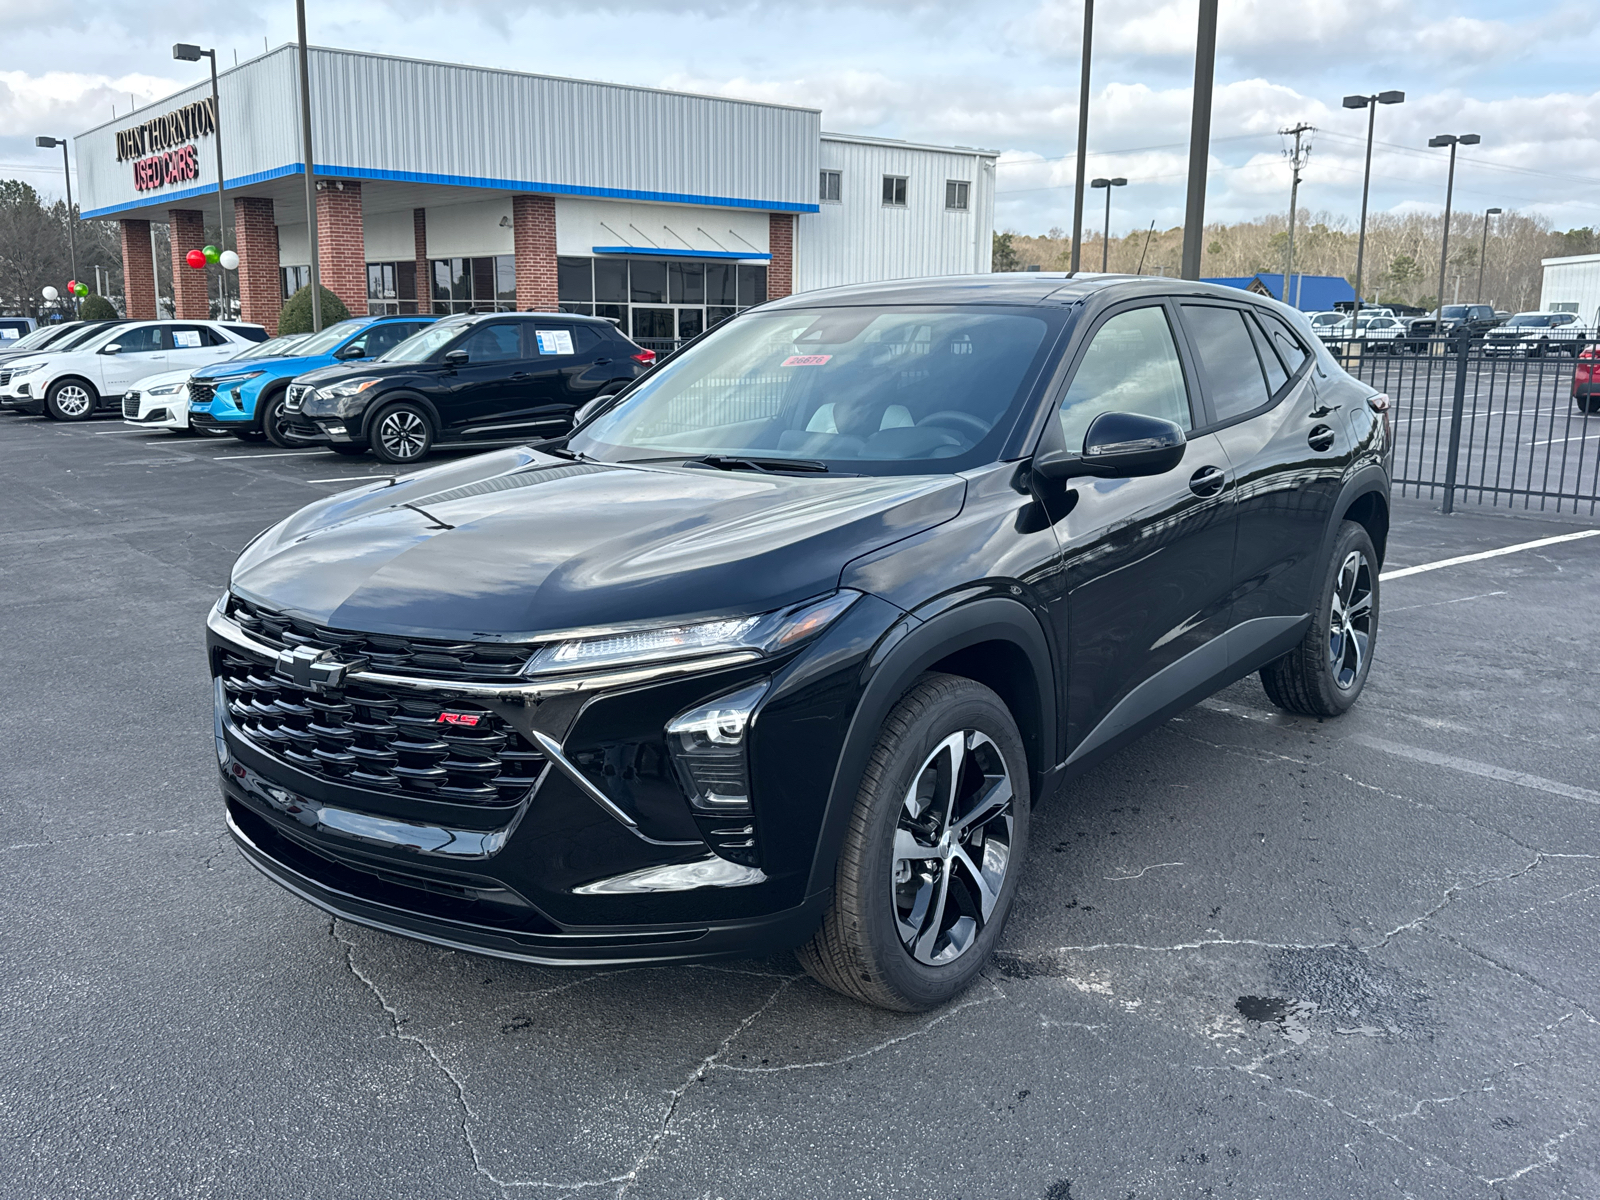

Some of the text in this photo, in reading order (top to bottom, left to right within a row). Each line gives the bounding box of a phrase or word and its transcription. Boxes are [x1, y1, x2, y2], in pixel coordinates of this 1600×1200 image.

[115, 96, 217, 162] JOHN THORNTON
[133, 144, 198, 192] USED CARS
[436, 712, 480, 726] RS
